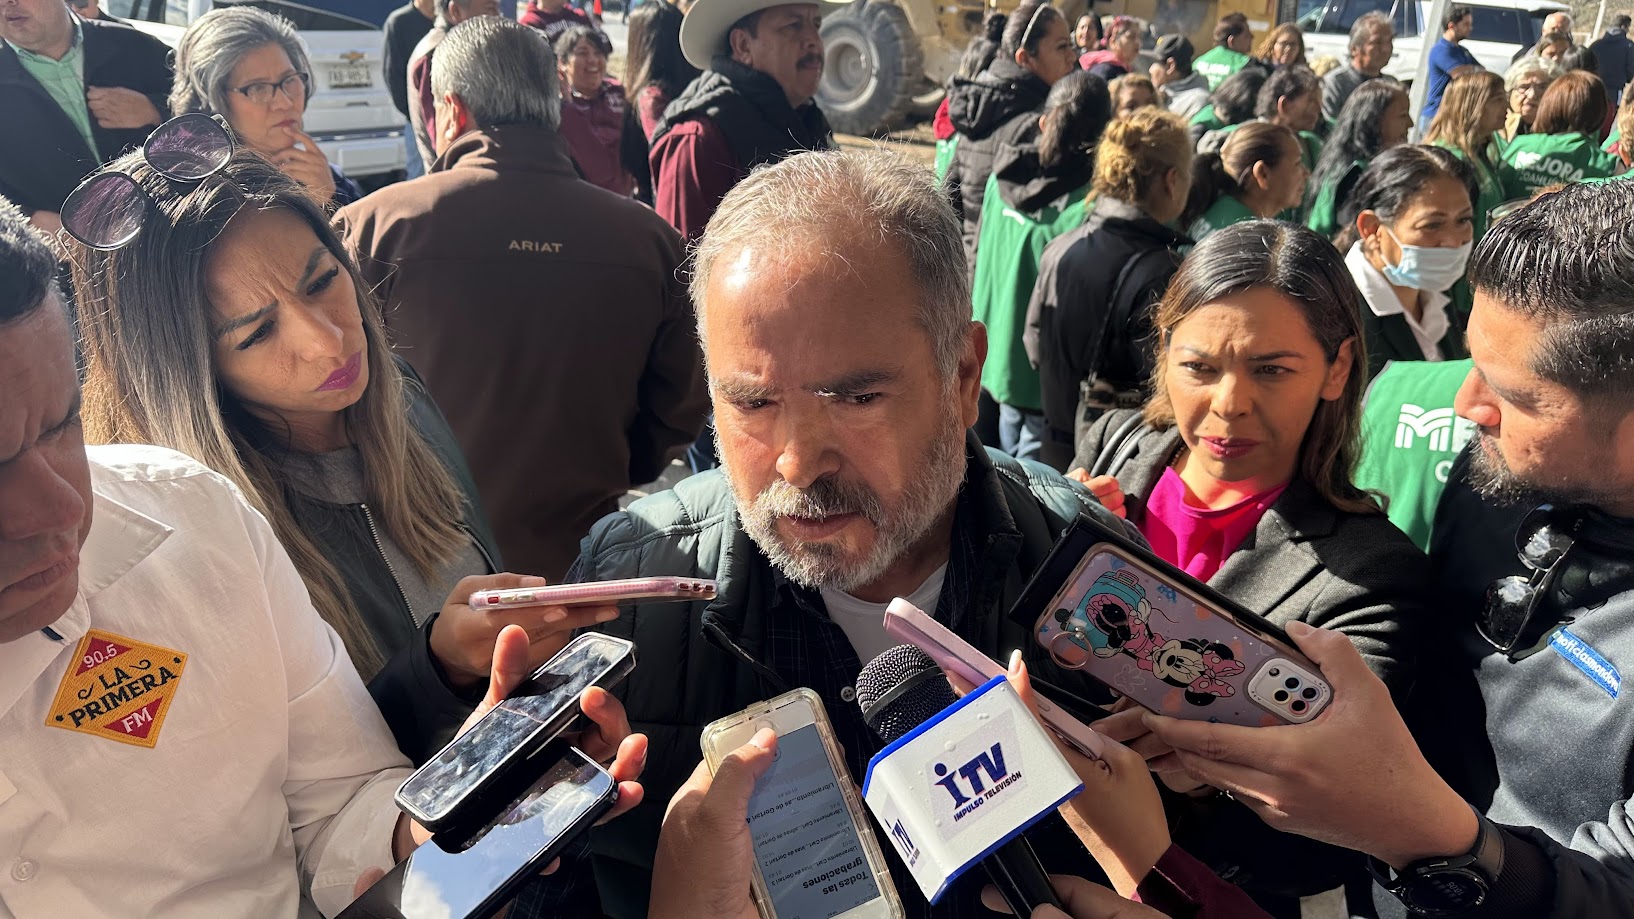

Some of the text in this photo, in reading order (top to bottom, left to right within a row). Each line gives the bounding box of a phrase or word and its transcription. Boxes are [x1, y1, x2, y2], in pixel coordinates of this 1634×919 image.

[509, 240, 563, 253] ARIAT
[83, 643, 117, 668] 90.5
[99, 666, 132, 690] LA
[68, 666, 179, 728] PRIMERA
[121, 707, 153, 733] FM
[953, 770, 1022, 822] IMPULSO TELEVISIÓN
[800, 857, 864, 891] grabaciones
[821, 871, 868, 897] Todas las
